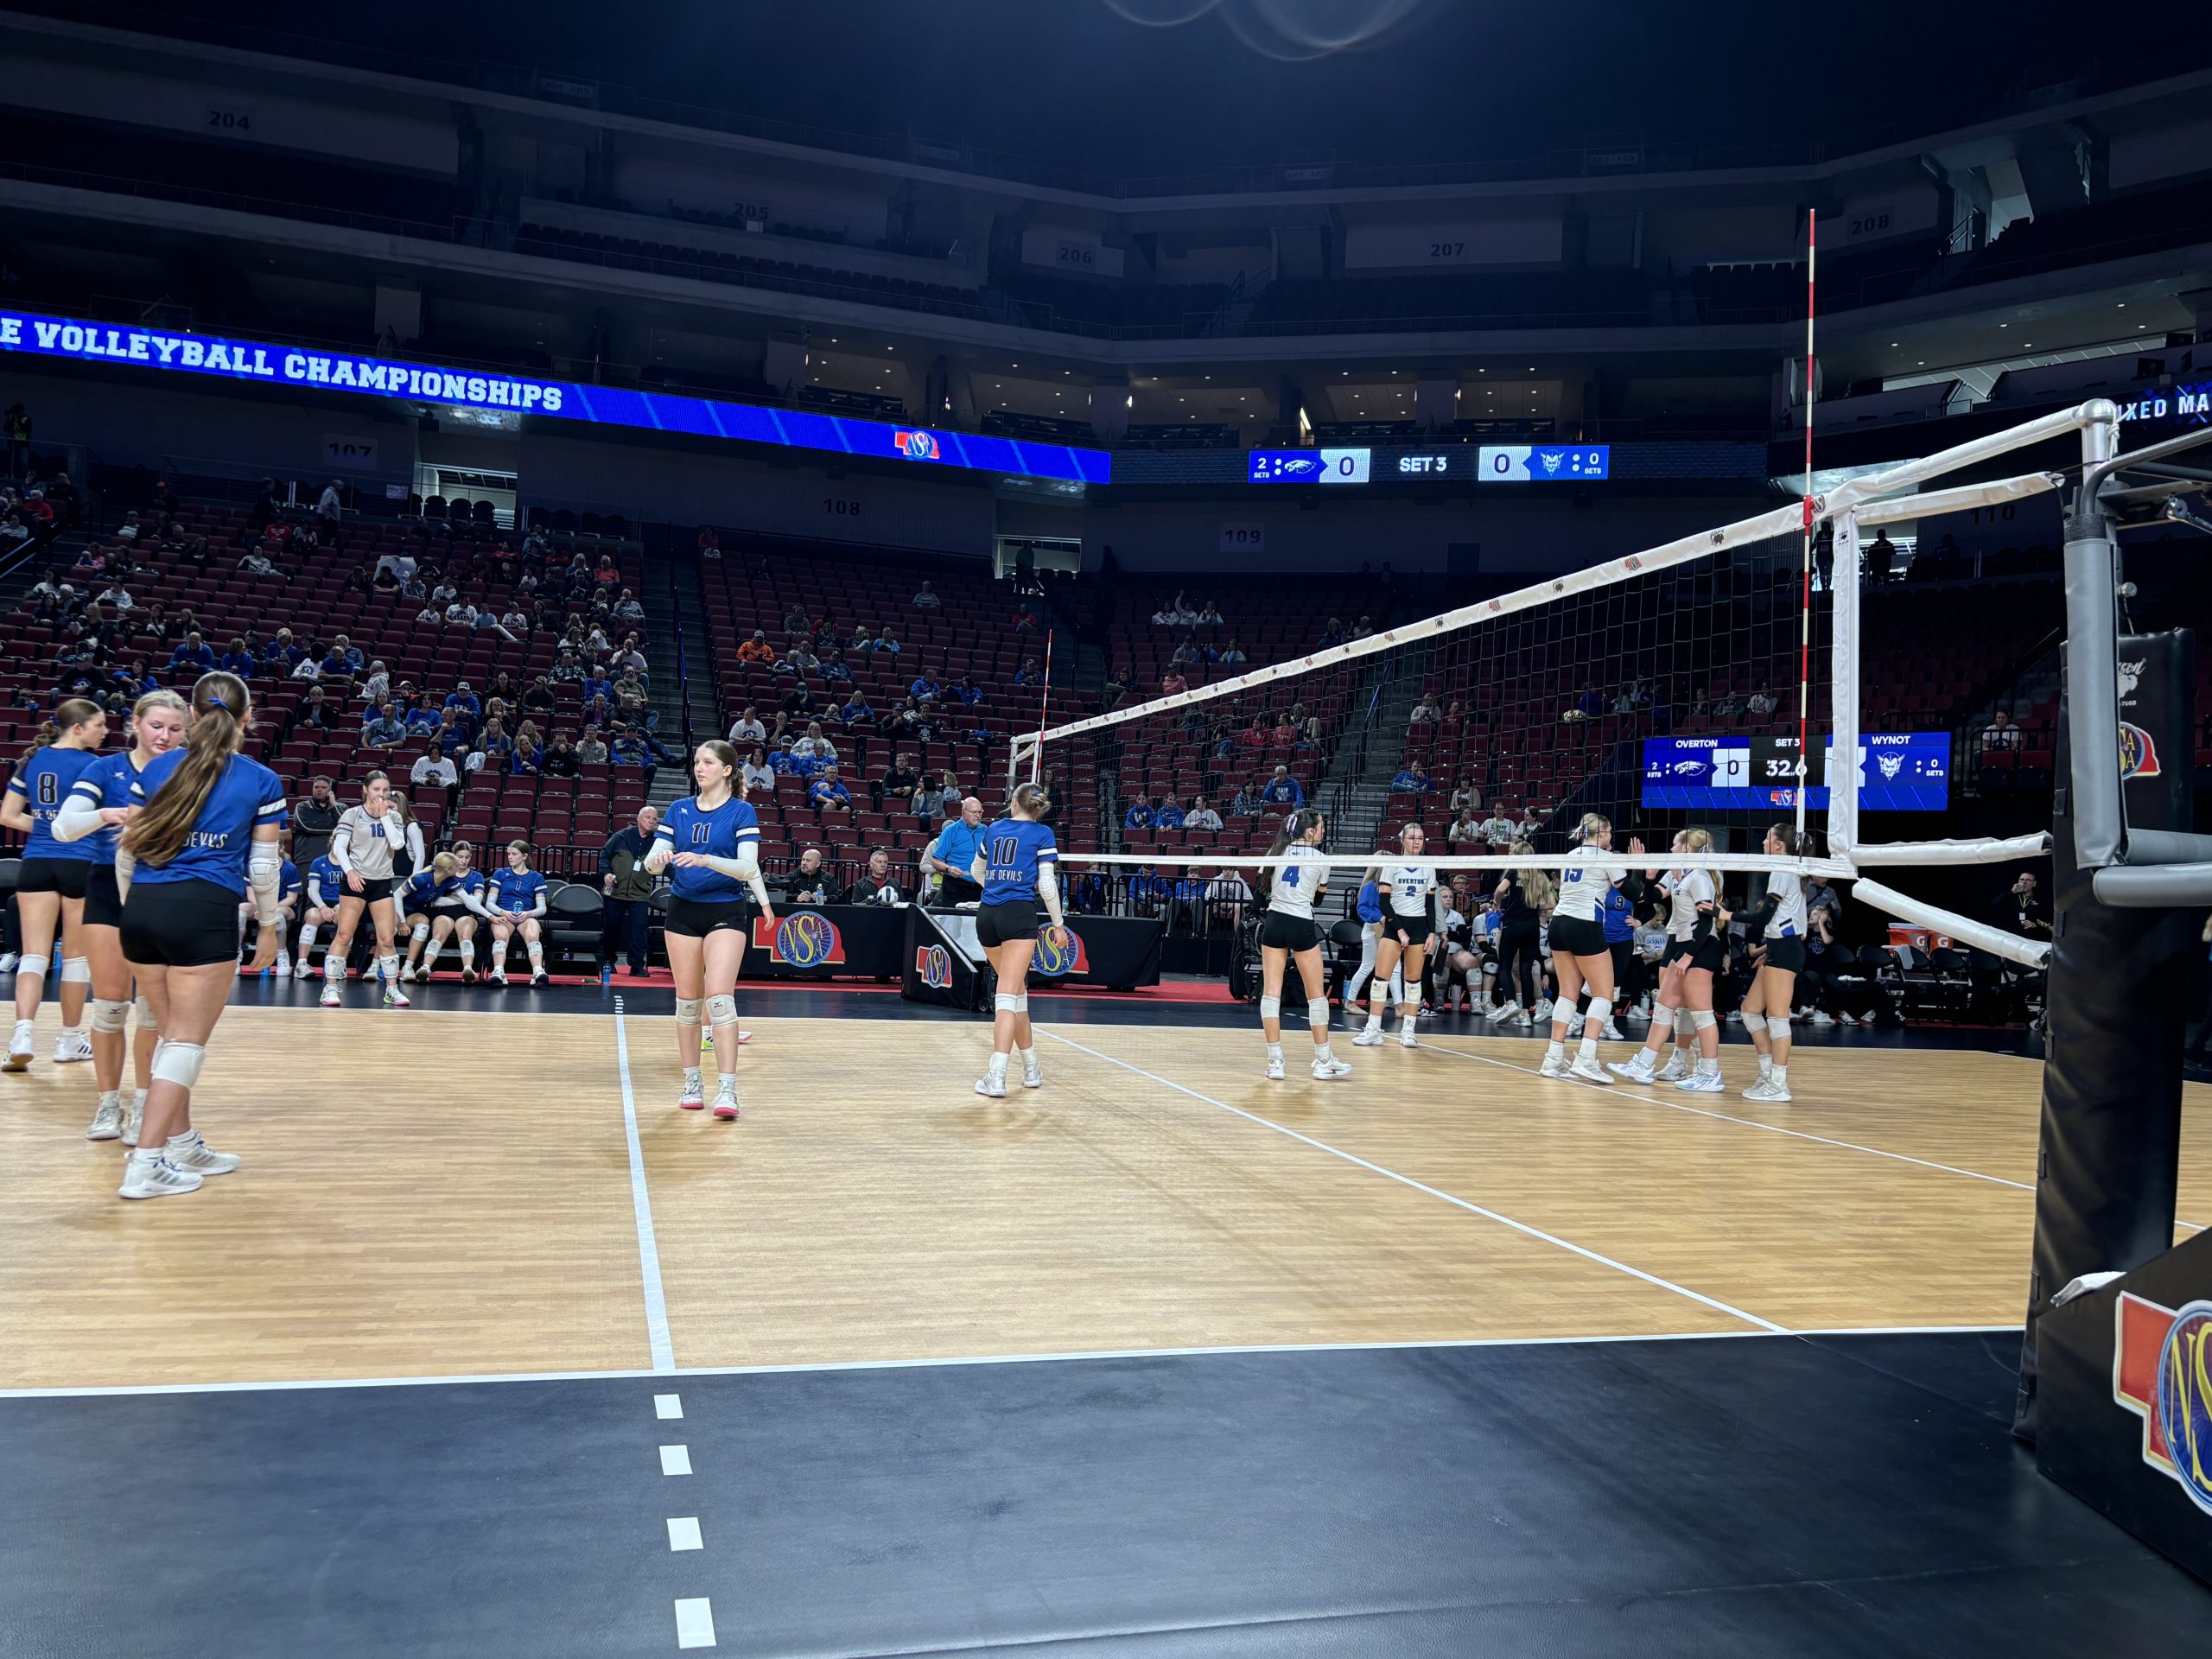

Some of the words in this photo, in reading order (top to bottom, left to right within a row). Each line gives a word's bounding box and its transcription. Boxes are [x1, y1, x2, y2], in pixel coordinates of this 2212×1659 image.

[208, 110, 251, 130] 204
[734, 202, 768, 219] 205
[1852, 213, 1889, 235] 208
[1059, 247, 1092, 264] 206
[1430, 242, 1465, 257] 207
[35, 321, 274, 376] VOLLEYBALL
[284, 353, 562, 410] CHAMPIONSHIPS
[329, 442, 372, 457] 107
[1257, 458, 1266, 468] 2
[1339, 456, 1355, 476] 0
[1399, 457, 1429, 472] SET
[1436, 457, 1447, 472] 3
[1494, 454, 1510, 474] 0
[1590, 454, 1599, 465] 0
[823, 499, 861, 516] 108
[1969, 505, 2016, 524] 110
[1225, 530, 1261, 543] 109
[1675, 739, 1719, 748] OVERTON
[1775, 739, 1792, 747] SET
[1795, 738, 1801, 747] 3
[1872, 735, 1911, 745] WYNOT
[1651, 762, 1658, 771] 2
[1727, 760, 1739, 775] 0
[1930, 759, 1938, 767] 0
[38, 772, 58, 805] 8
[692, 822, 712, 843] 11
[992, 836, 1019, 866] 10
[998, 870, 1023, 881] DEVILS
[1281, 865, 1300, 887] 4
[515, 880, 522, 891] 1
[1405, 885, 1416, 897] 2
[1614, 895, 1625, 910] 9
[1916, 936, 1925, 946] G
[1937, 937, 1948, 948] G
